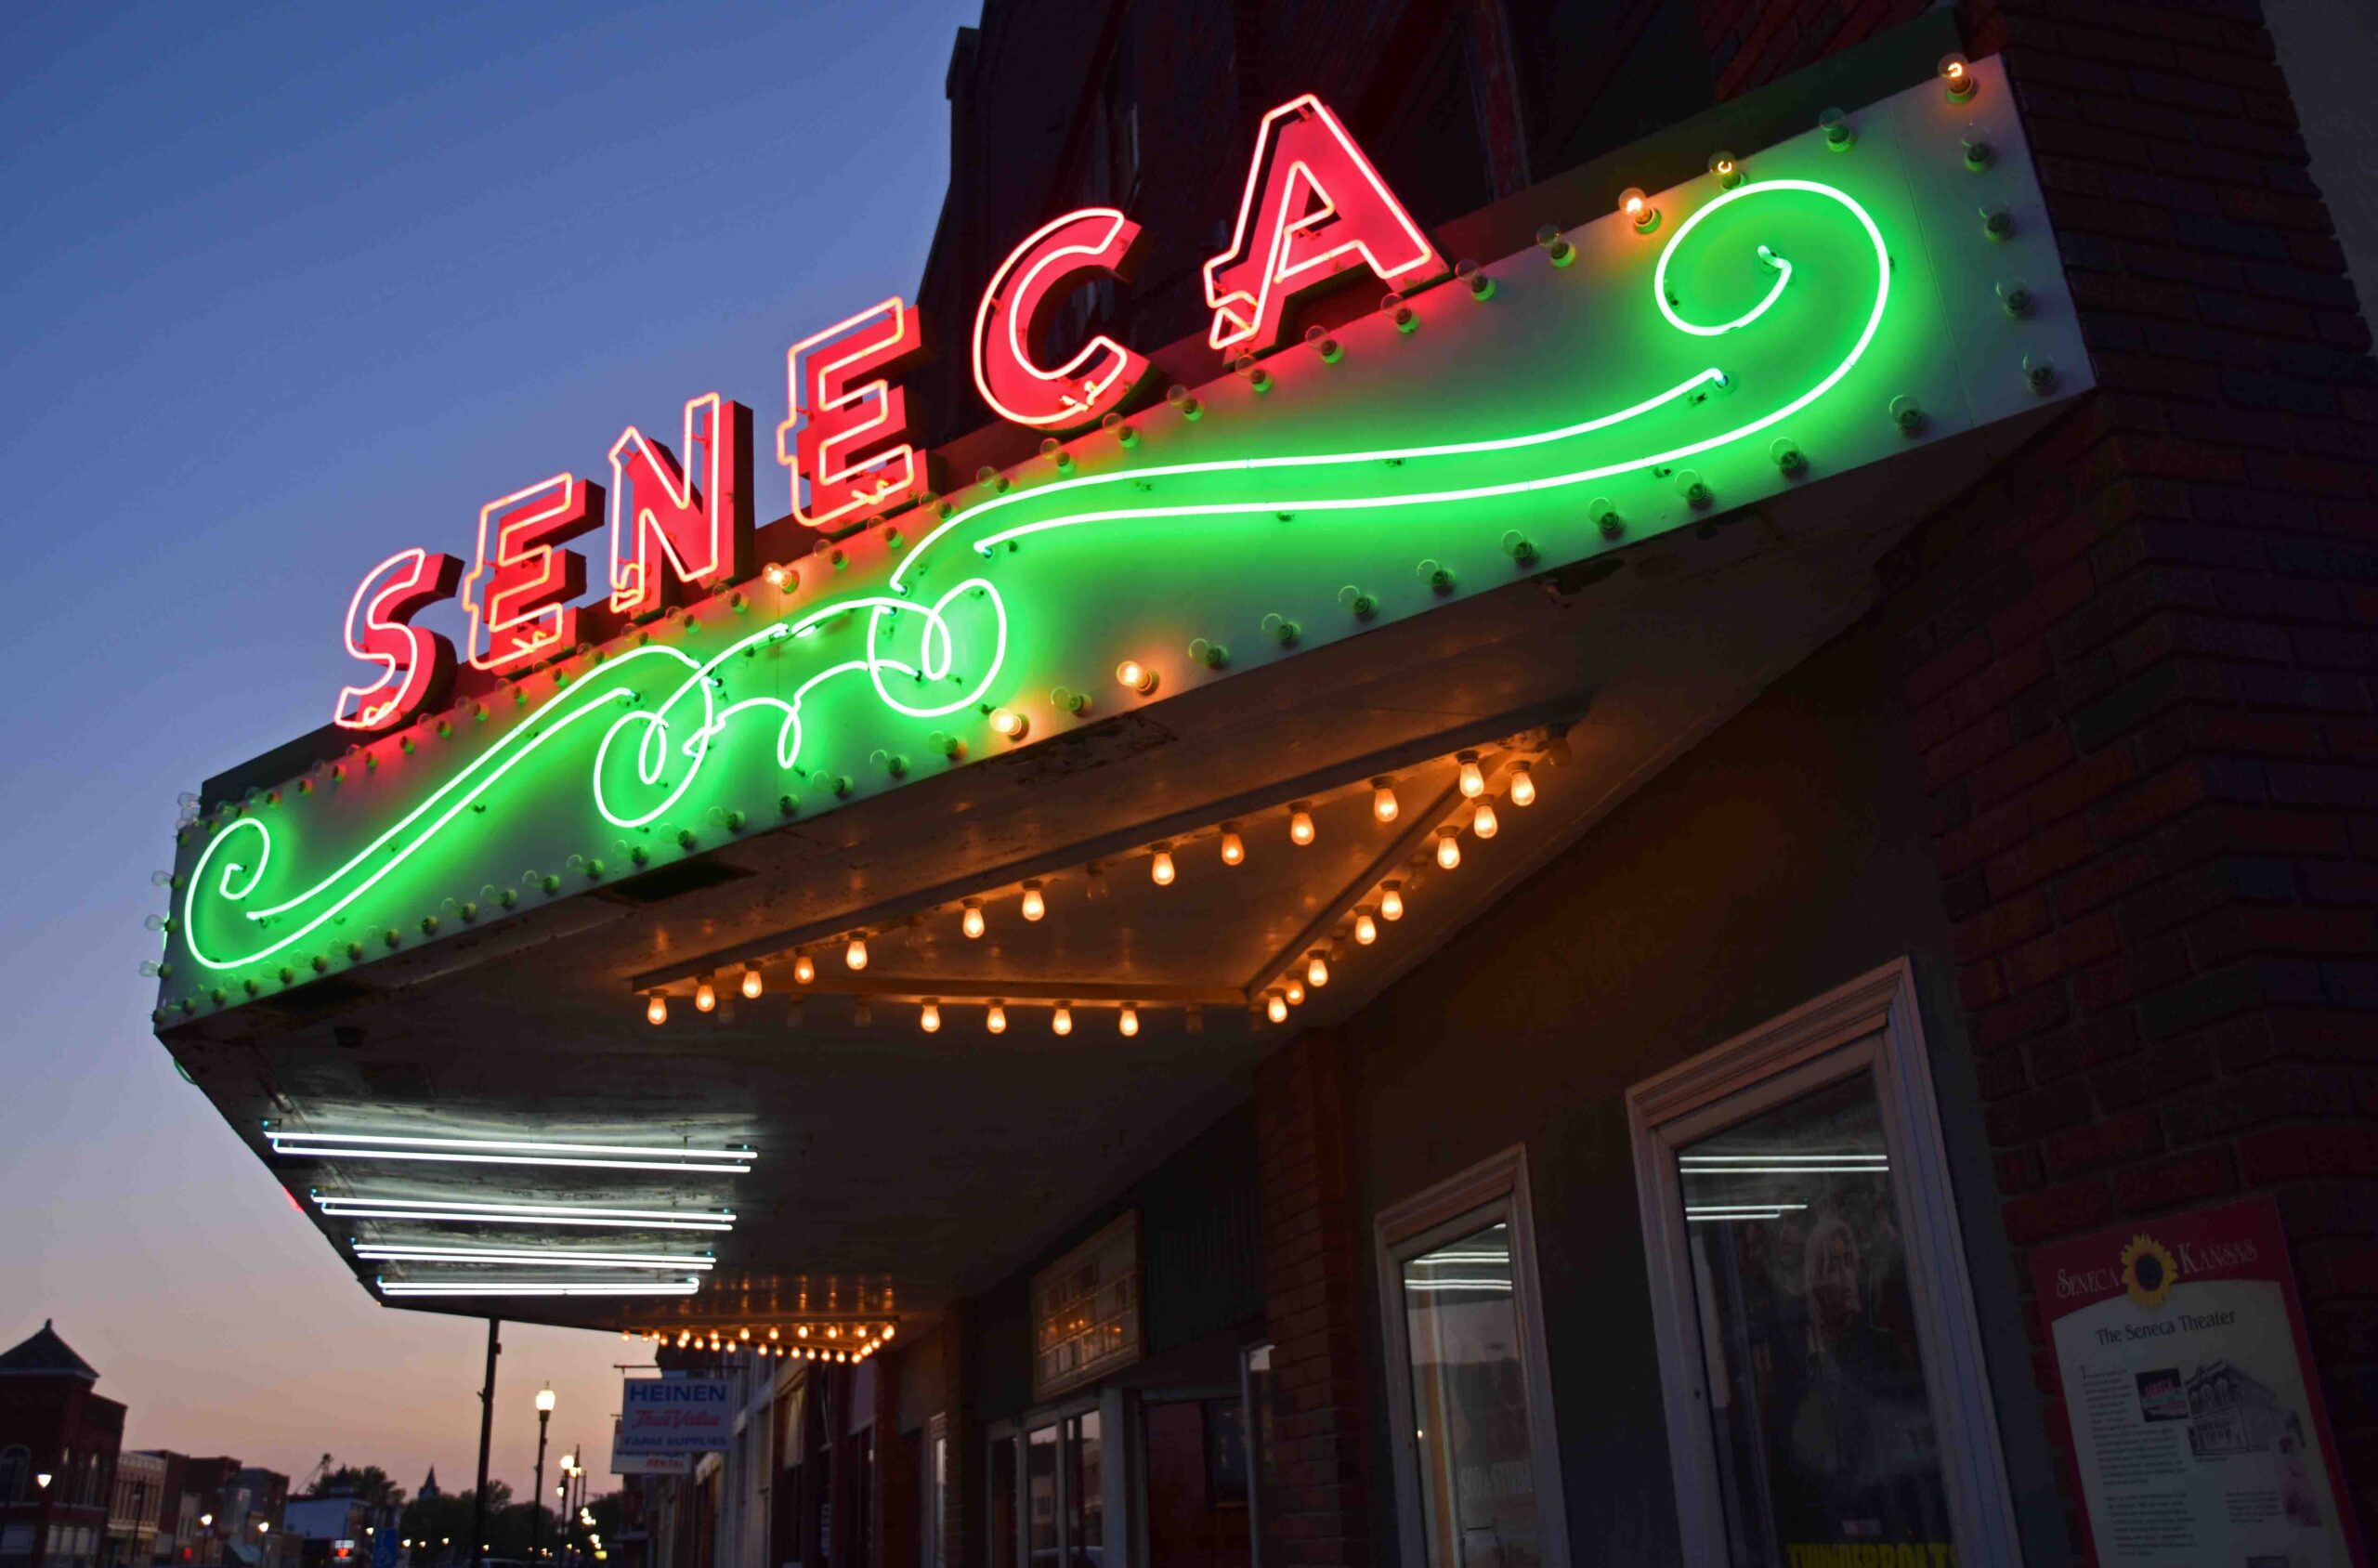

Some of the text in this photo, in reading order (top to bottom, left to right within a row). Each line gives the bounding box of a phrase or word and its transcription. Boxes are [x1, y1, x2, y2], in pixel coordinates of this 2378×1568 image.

[333, 93, 1449, 734] SENECA
[2055, 1237, 2259, 1299] SENECA KANSAS
[2095, 1308, 2237, 1346] The Seneca Theater
[629, 1384, 726, 1403] HEINEN
